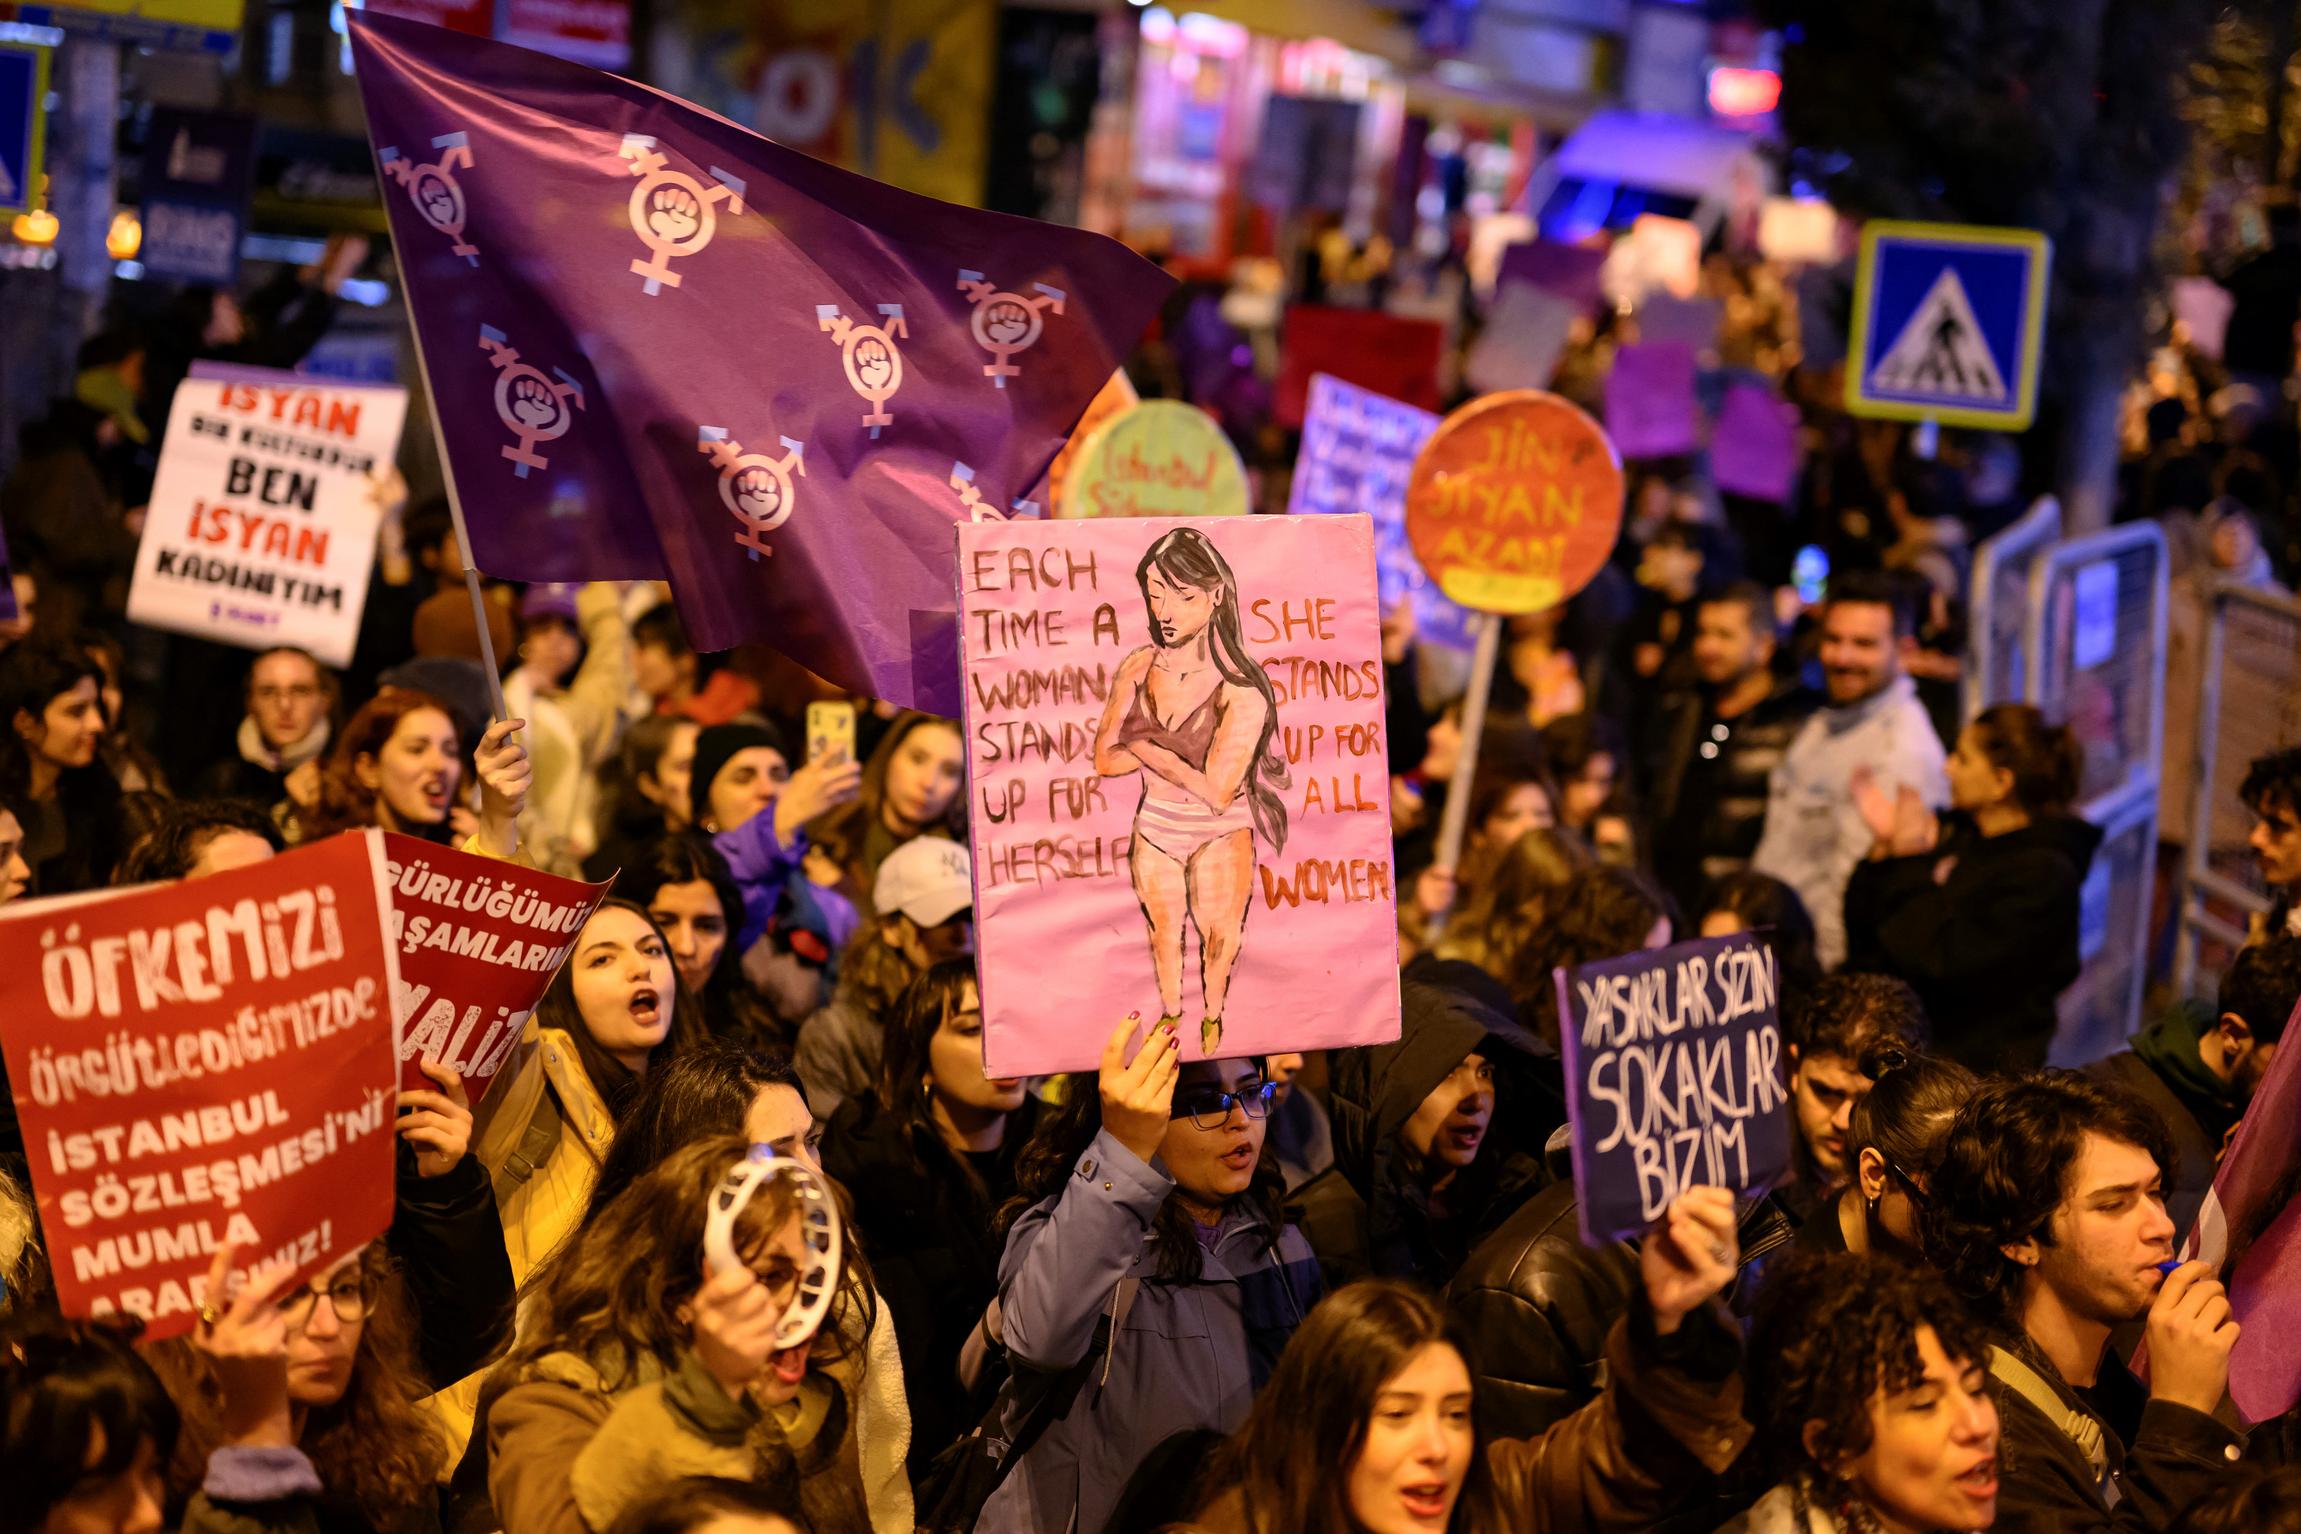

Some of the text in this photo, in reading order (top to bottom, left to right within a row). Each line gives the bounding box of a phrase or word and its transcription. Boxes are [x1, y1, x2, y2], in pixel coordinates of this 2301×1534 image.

[226, 455, 319, 512] BEN
[967, 547, 1098, 594] EACH
[970, 602, 1120, 654] TIME A
[1250, 598, 1336, 643] SHE
[971, 663, 1107, 713] WOMAN
[1261, 656, 1380, 708] STANDS
[979, 717, 1097, 764] STANDS
[1284, 721, 1381, 764] UP FOR
[983, 775, 1108, 824] UP FOR
[1300, 773, 1379, 821] ALL
[988, 834, 1132, 892] HERSELF
[1259, 858, 1390, 910] WOMEN
[1588, 1025, 1788, 1153] SOKAKLAR
[47, 1089, 290, 1175] İSTANBUL
[1634, 1119, 1749, 1222] BİZİM
[71, 1212, 260, 1283] MUMLA
